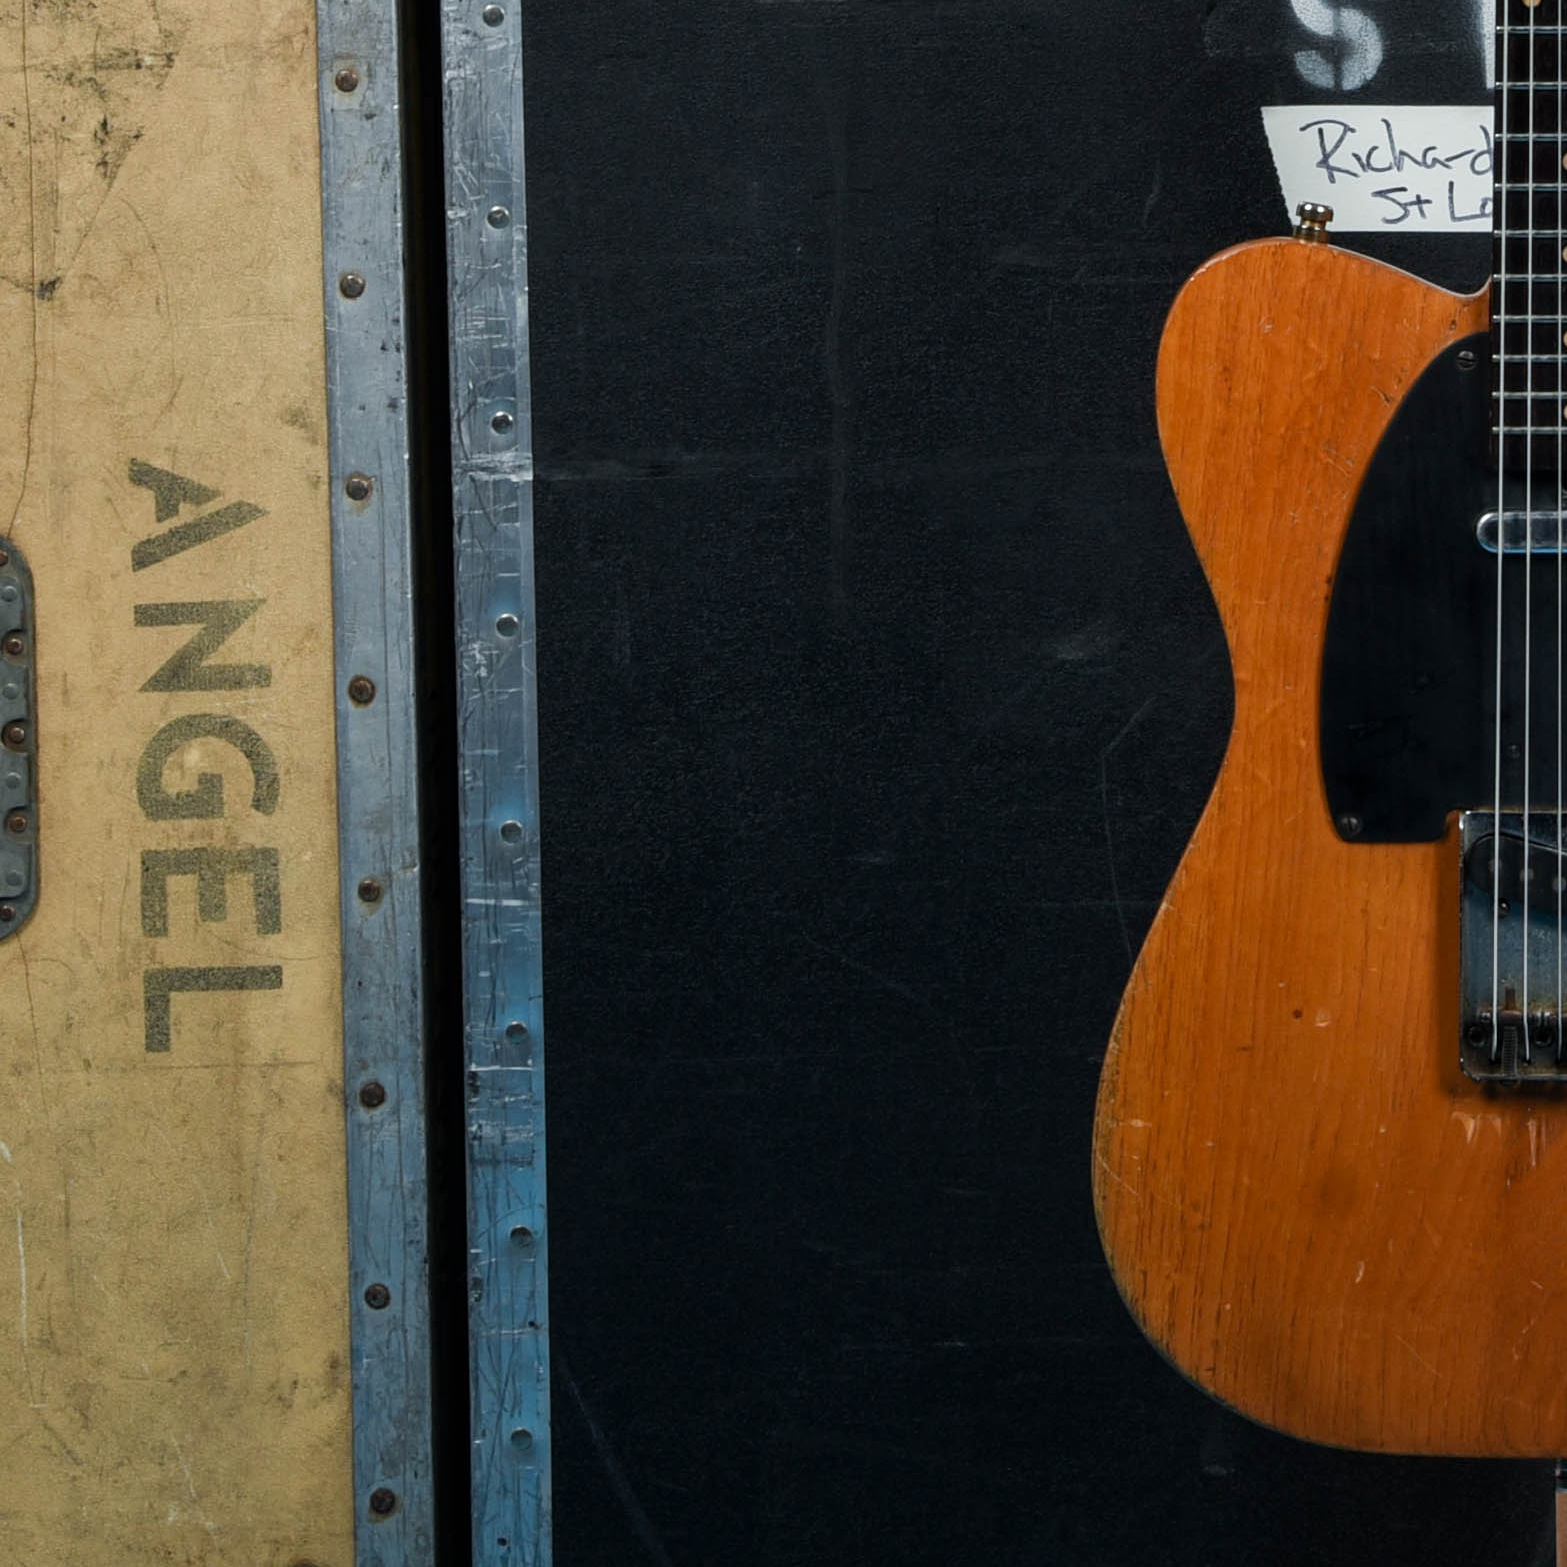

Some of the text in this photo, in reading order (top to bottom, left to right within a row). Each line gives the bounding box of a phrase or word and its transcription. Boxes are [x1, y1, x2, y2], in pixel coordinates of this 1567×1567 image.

[1300, 118, 1493, 184] Richard
[1371, 186, 1433, 224] St
[128, 457, 283, 1052] ANGEL
